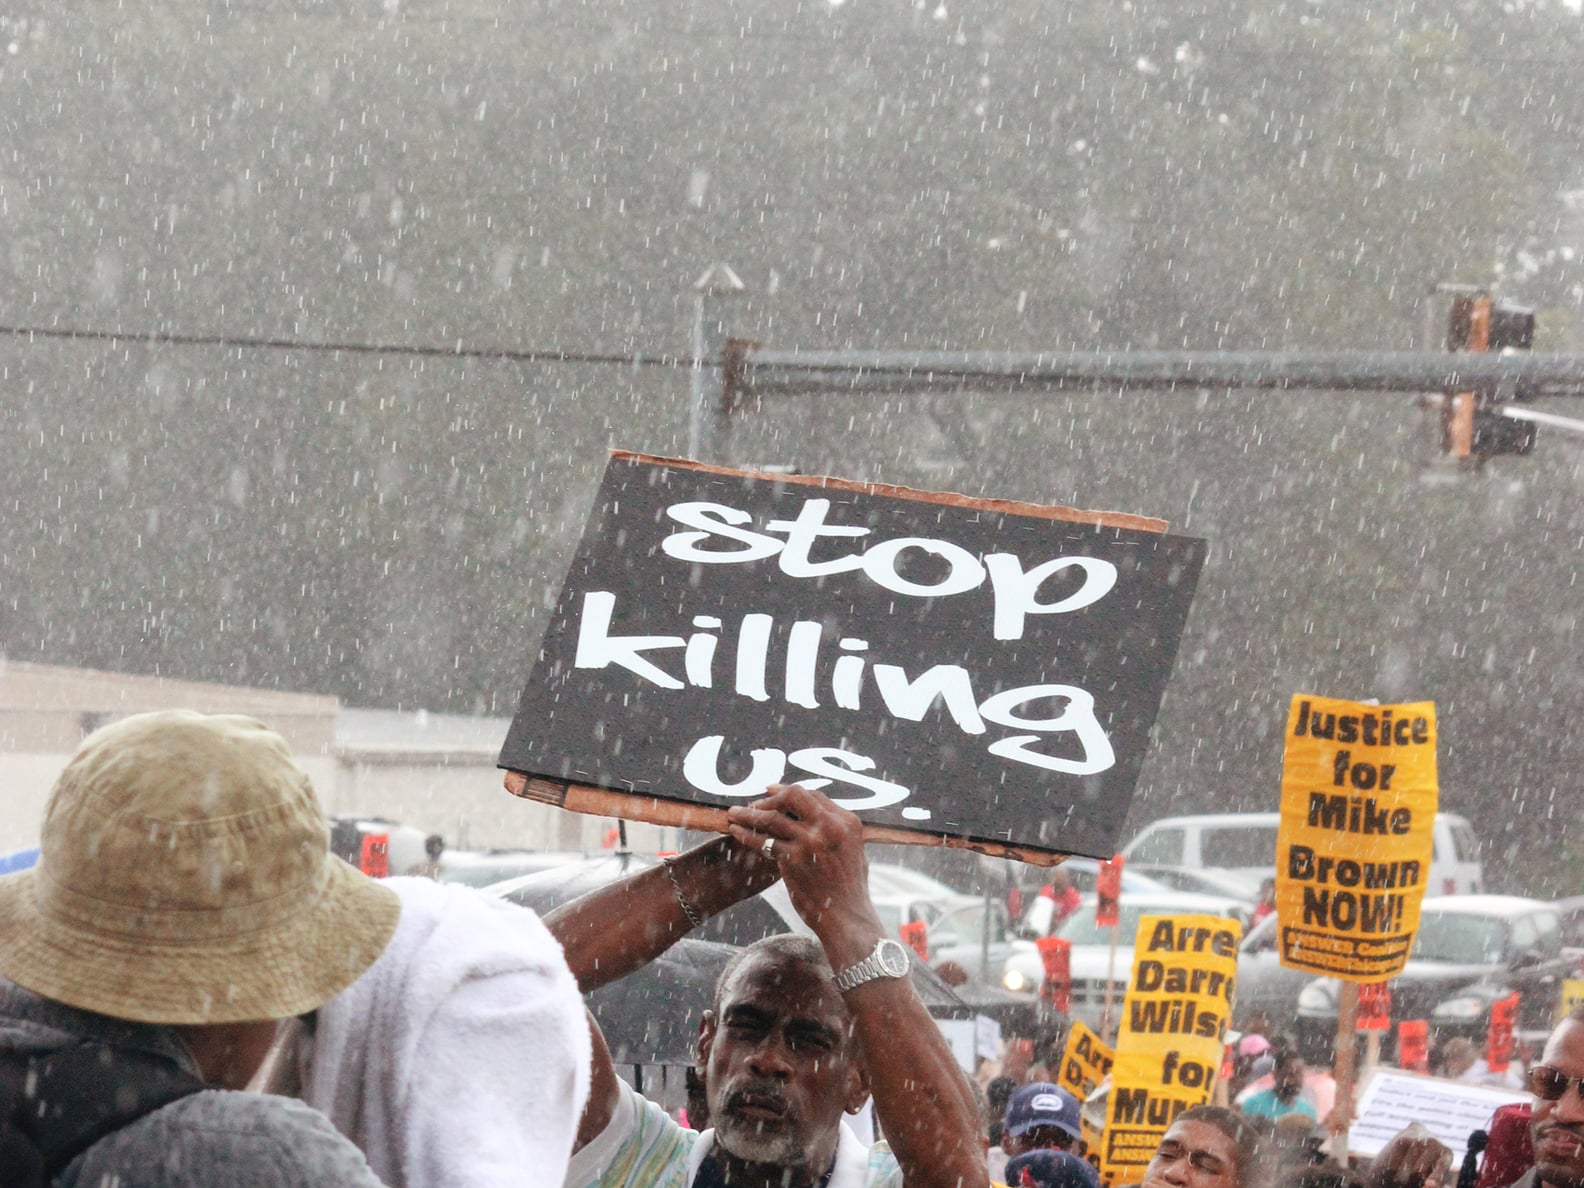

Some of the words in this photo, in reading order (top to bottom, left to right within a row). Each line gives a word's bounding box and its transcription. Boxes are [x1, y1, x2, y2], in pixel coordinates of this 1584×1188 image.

[662, 498, 1117, 640] stop
[574, 591, 1115, 774] killing
[1294, 701, 1429, 747] Justice
[683, 735, 931, 820] us.
[1333, 750, 1396, 790] for
[1308, 792, 1412, 835] Mike
[1289, 845, 1421, 888] Brown
[1303, 887, 1404, 933] NOW!
[1147, 919, 1239, 961] Arre
